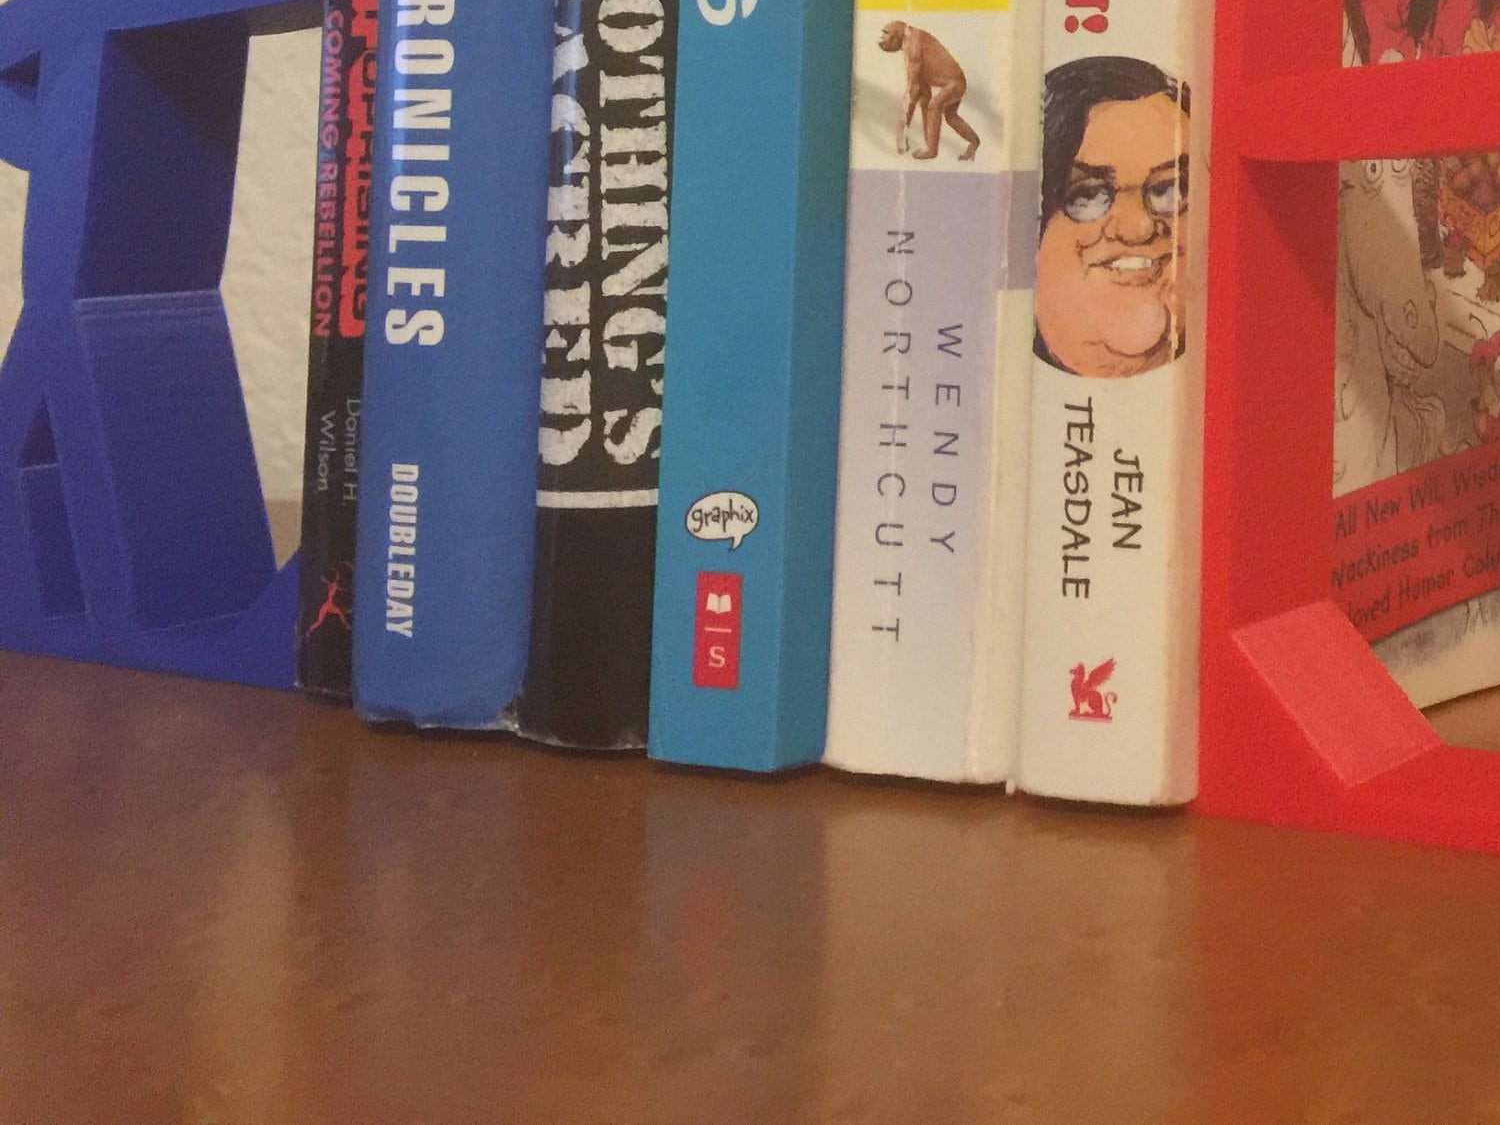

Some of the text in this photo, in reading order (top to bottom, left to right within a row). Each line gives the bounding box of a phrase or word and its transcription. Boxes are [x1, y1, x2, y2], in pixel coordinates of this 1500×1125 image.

[318, 10, 345, 148] COMING
[312, 162, 338, 338] REBELLION
[317, 411, 336, 491] Wilson
[872, 231, 915, 642] NORTHCUTT
[930, 325, 963, 553] WENDY
[1061, 397, 1095, 598] TEASDALE
[1111, 449, 1144, 549] JEAN
[386, 464, 419, 637] DOUBLEDAY
[692, 496, 756, 533] graphix
[1333, 508, 1357, 543] All
[1365, 496, 1400, 525] New
[1398, 568, 1456, 604] Humor
